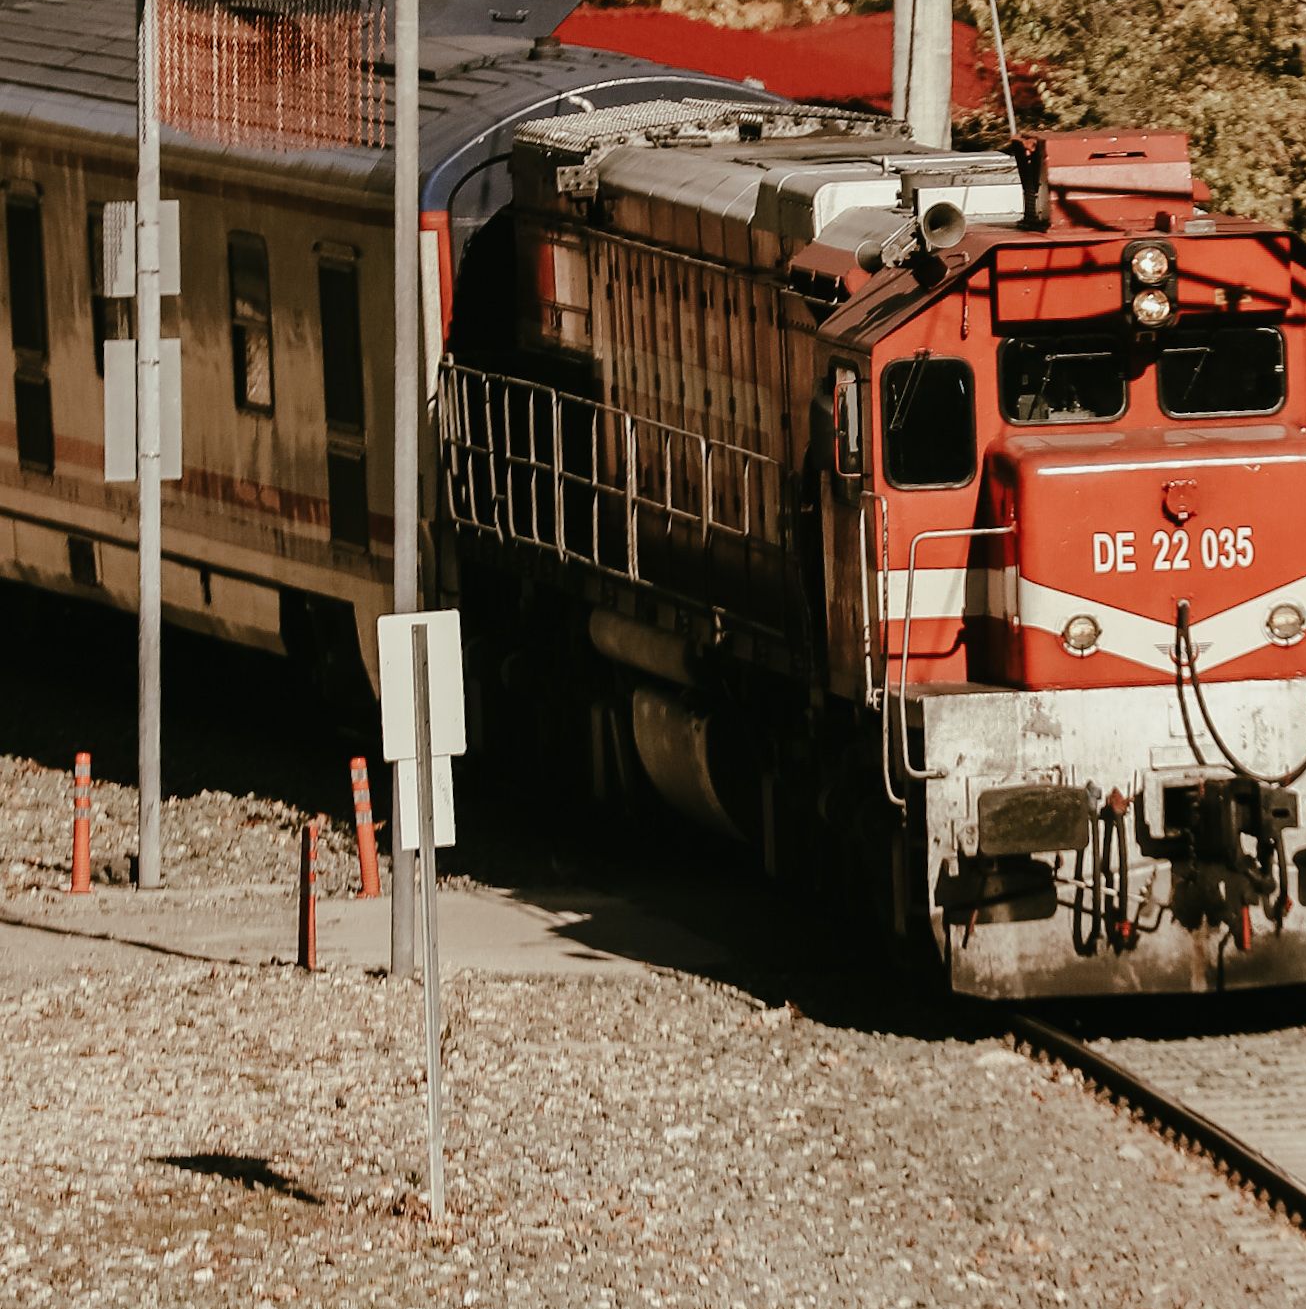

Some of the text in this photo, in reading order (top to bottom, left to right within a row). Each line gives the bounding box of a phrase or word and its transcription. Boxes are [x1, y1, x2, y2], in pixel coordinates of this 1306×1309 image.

[1092, 525, 1255, 574] DE 22 035
